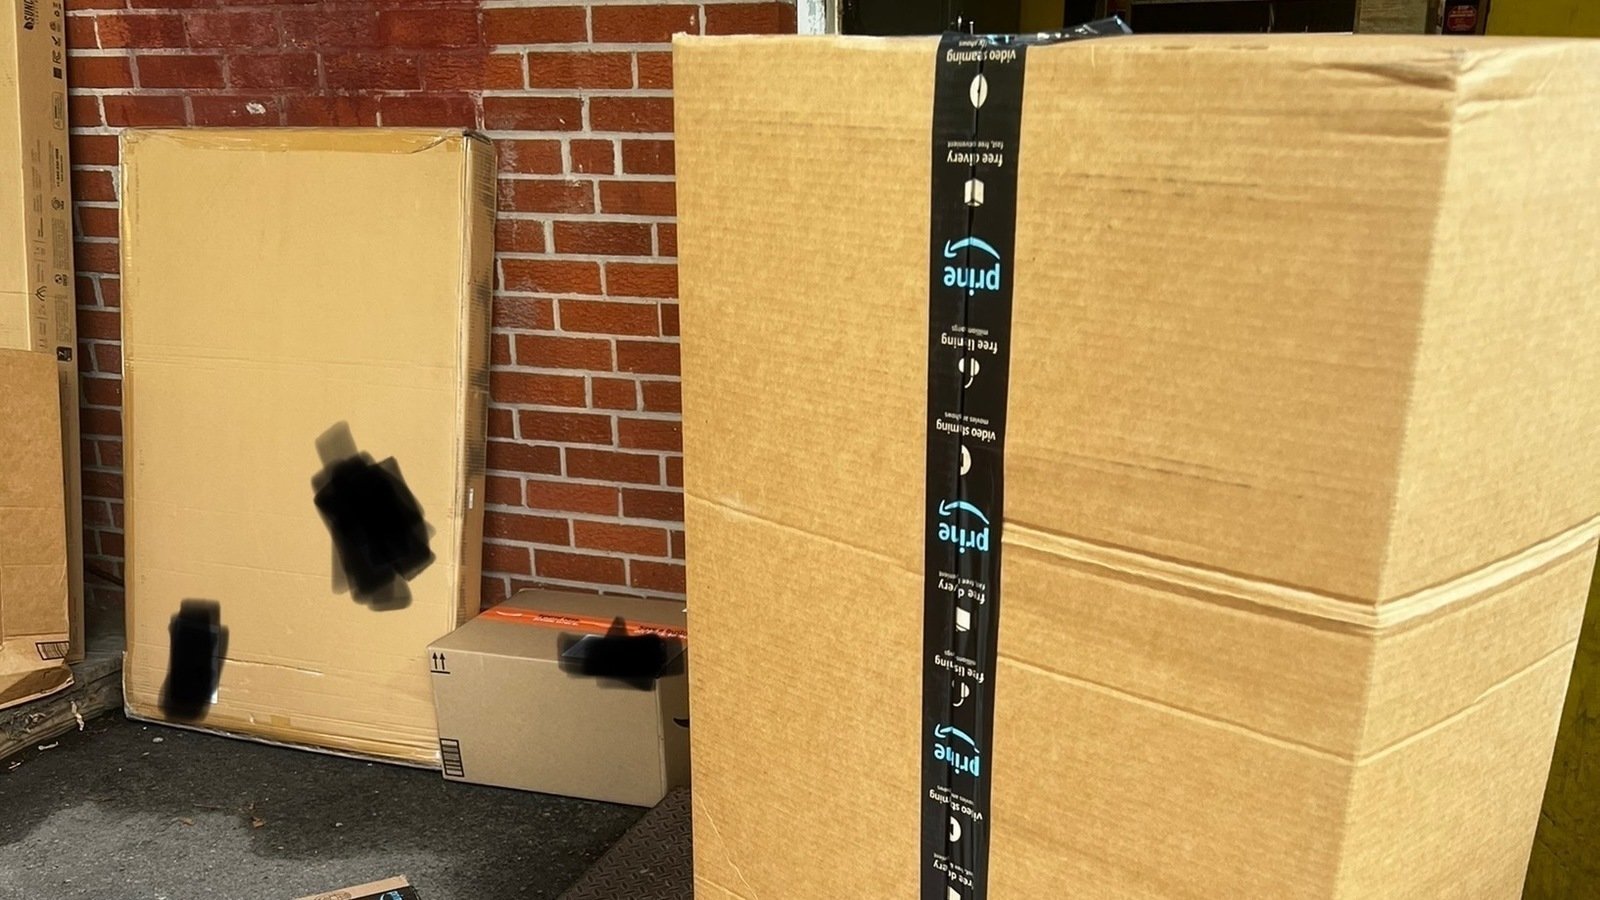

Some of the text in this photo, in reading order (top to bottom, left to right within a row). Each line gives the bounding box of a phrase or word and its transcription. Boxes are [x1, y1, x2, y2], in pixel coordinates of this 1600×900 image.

[946, 49, 1016, 64] video seaming
[947, 150, 1003, 167] free divery
[941, 332, 998, 354] free lining
[936, 419, 996, 442] video stming
[968, 589, 985, 604] fre
[962, 806, 983, 822] vieo
[959, 875, 973, 890] ree
